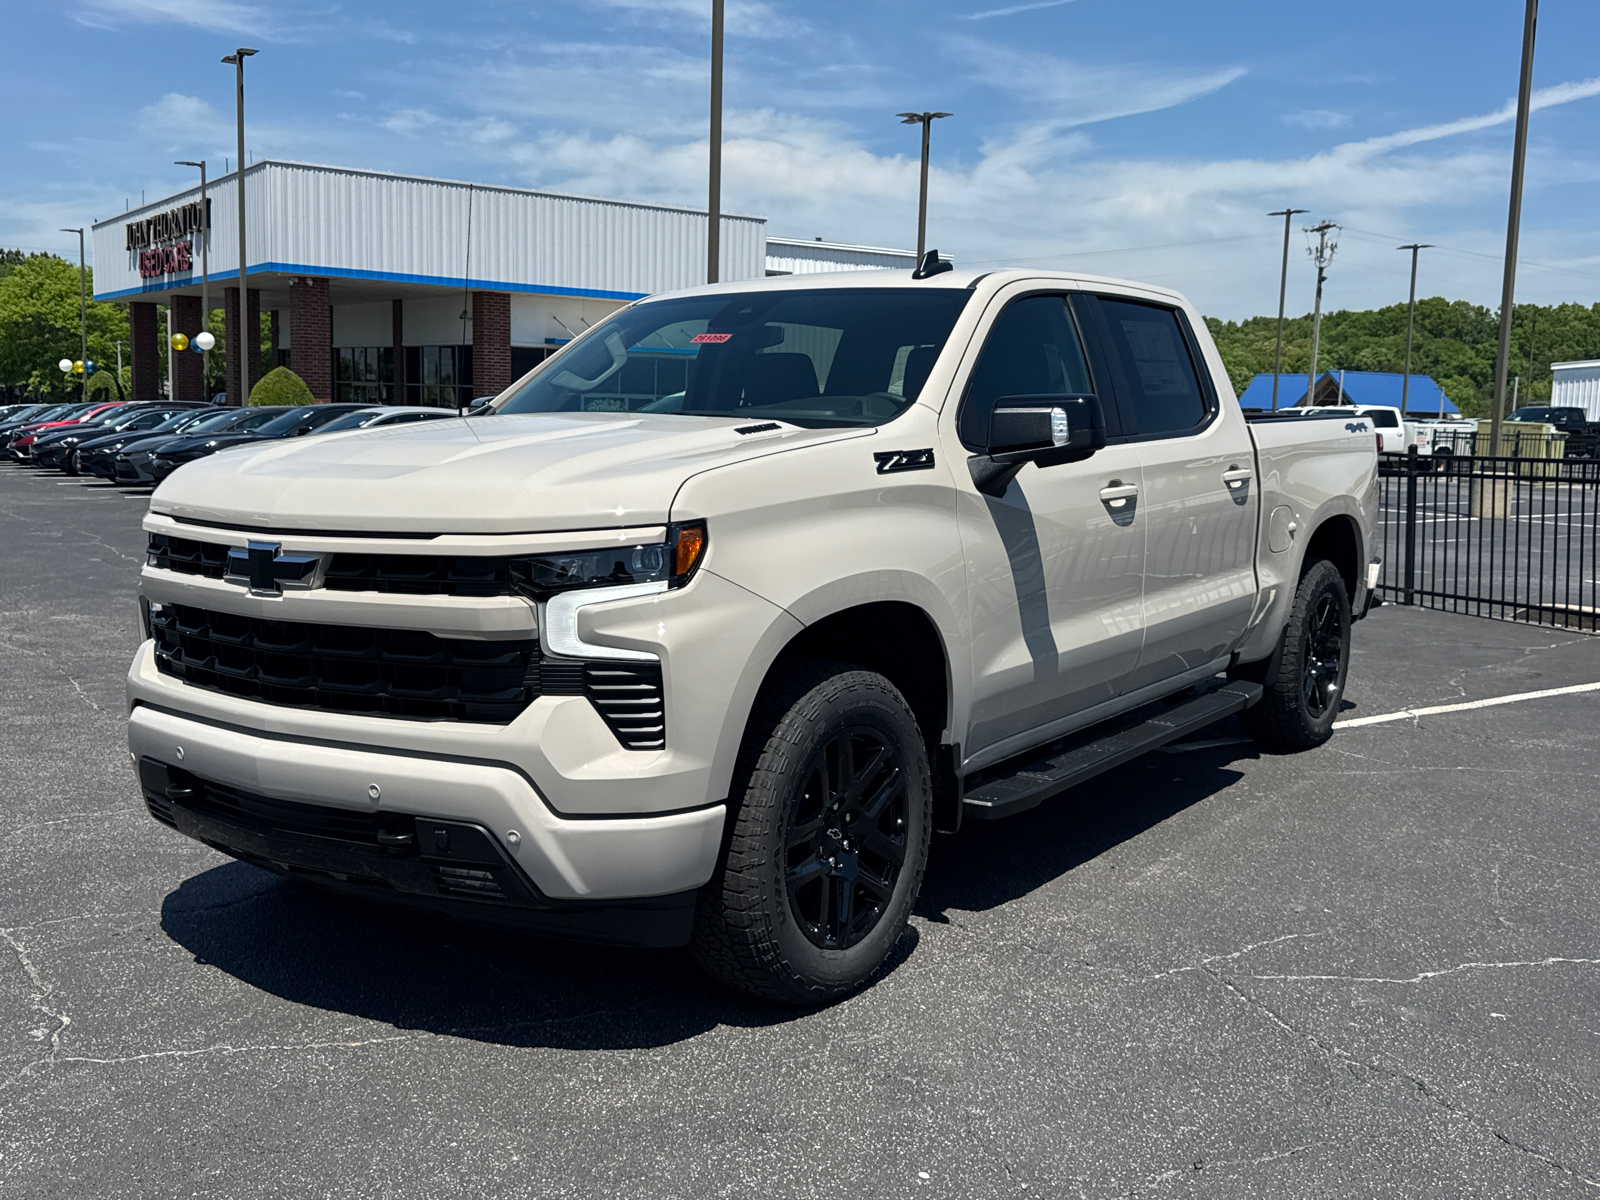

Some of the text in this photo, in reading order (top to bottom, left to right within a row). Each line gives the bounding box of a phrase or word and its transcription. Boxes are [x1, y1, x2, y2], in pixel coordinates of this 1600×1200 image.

[126, 219, 150, 251] JOHN
[139, 240, 190, 279] USED CARS
